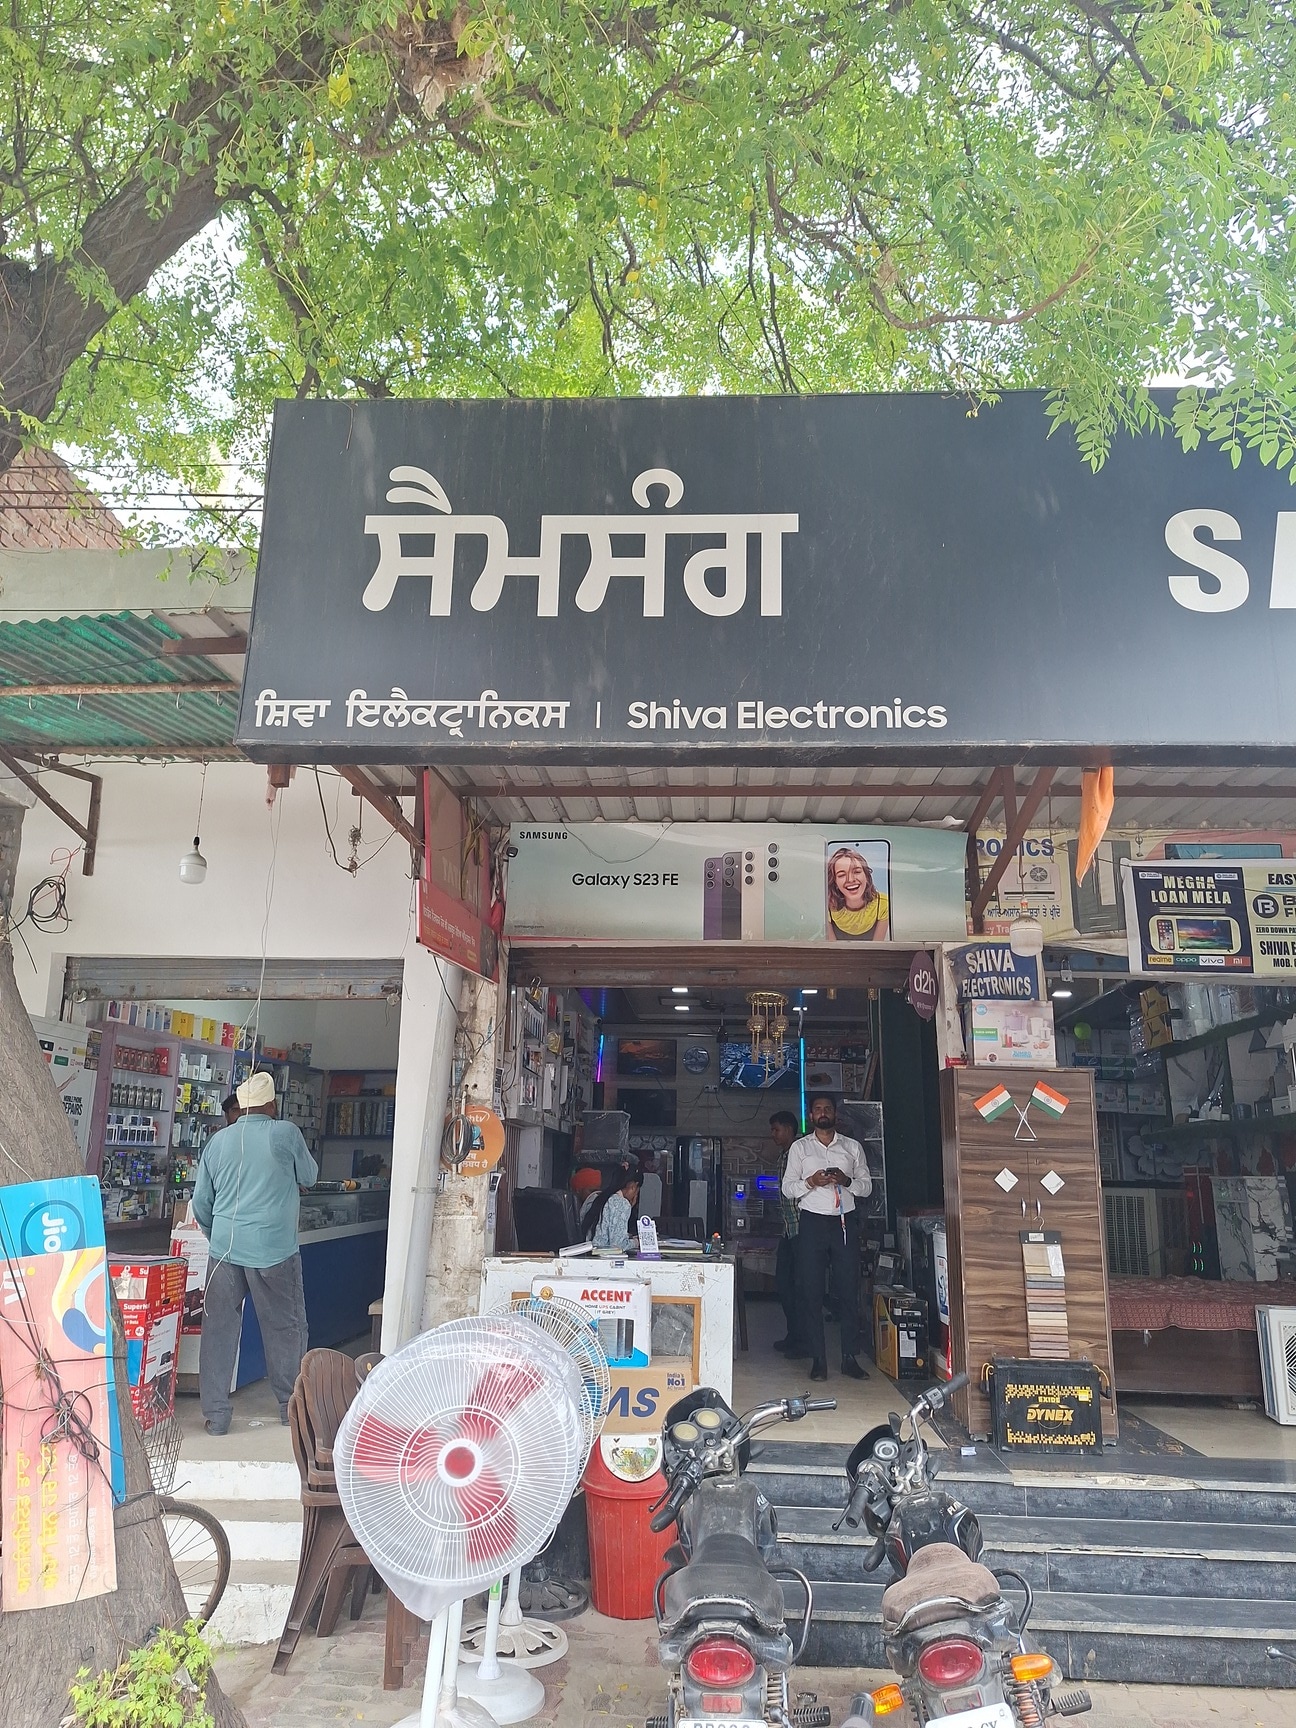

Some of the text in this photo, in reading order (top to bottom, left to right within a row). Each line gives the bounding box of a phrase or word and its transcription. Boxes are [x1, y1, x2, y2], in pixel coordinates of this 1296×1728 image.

[362, 465, 800, 617] ਸੈਮਸੰਗ
[1165, 508, 1296, 613] S
[254, 688, 332, 728] ਸ਼ਿਵਾ
[345, 686, 571, 738] ਇਲੈਕਟ੍ਰਾਨਿਕਸ
[626, 698, 728, 730] Shiva
[737, 697, 948, 730] Electronics
[519, 831, 568, 840] SAMSUNG
[975, 838, 1055, 857] ROICS
[572, 873, 679, 889] Galaxy S23 FE
[1163, 875, 1216, 889] MEGHA
[1151, 890, 1232, 905] LOAN MELA
[1255, 926, 1270, 934] ZERO
[1270, 926, 1288, 934] DOWN
[1259, 940, 1290, 956] SHIVA
[966, 949, 1016, 974] SHIVA
[1149, 955, 1172, 964] realme
[1273, 957, 1293, 968] MOB.
[913, 969, 936, 996] d2h
[962, 976, 1032, 998] ELECTRONICS
[41, 1212, 68, 1253] Jio
[580, 1288, 633, 1303] ACCENT
[667, 1378, 686, 1387] No1
[1026, 1408, 1075, 1422] DYNEX
[68, 1473, 79, 1486] 12
